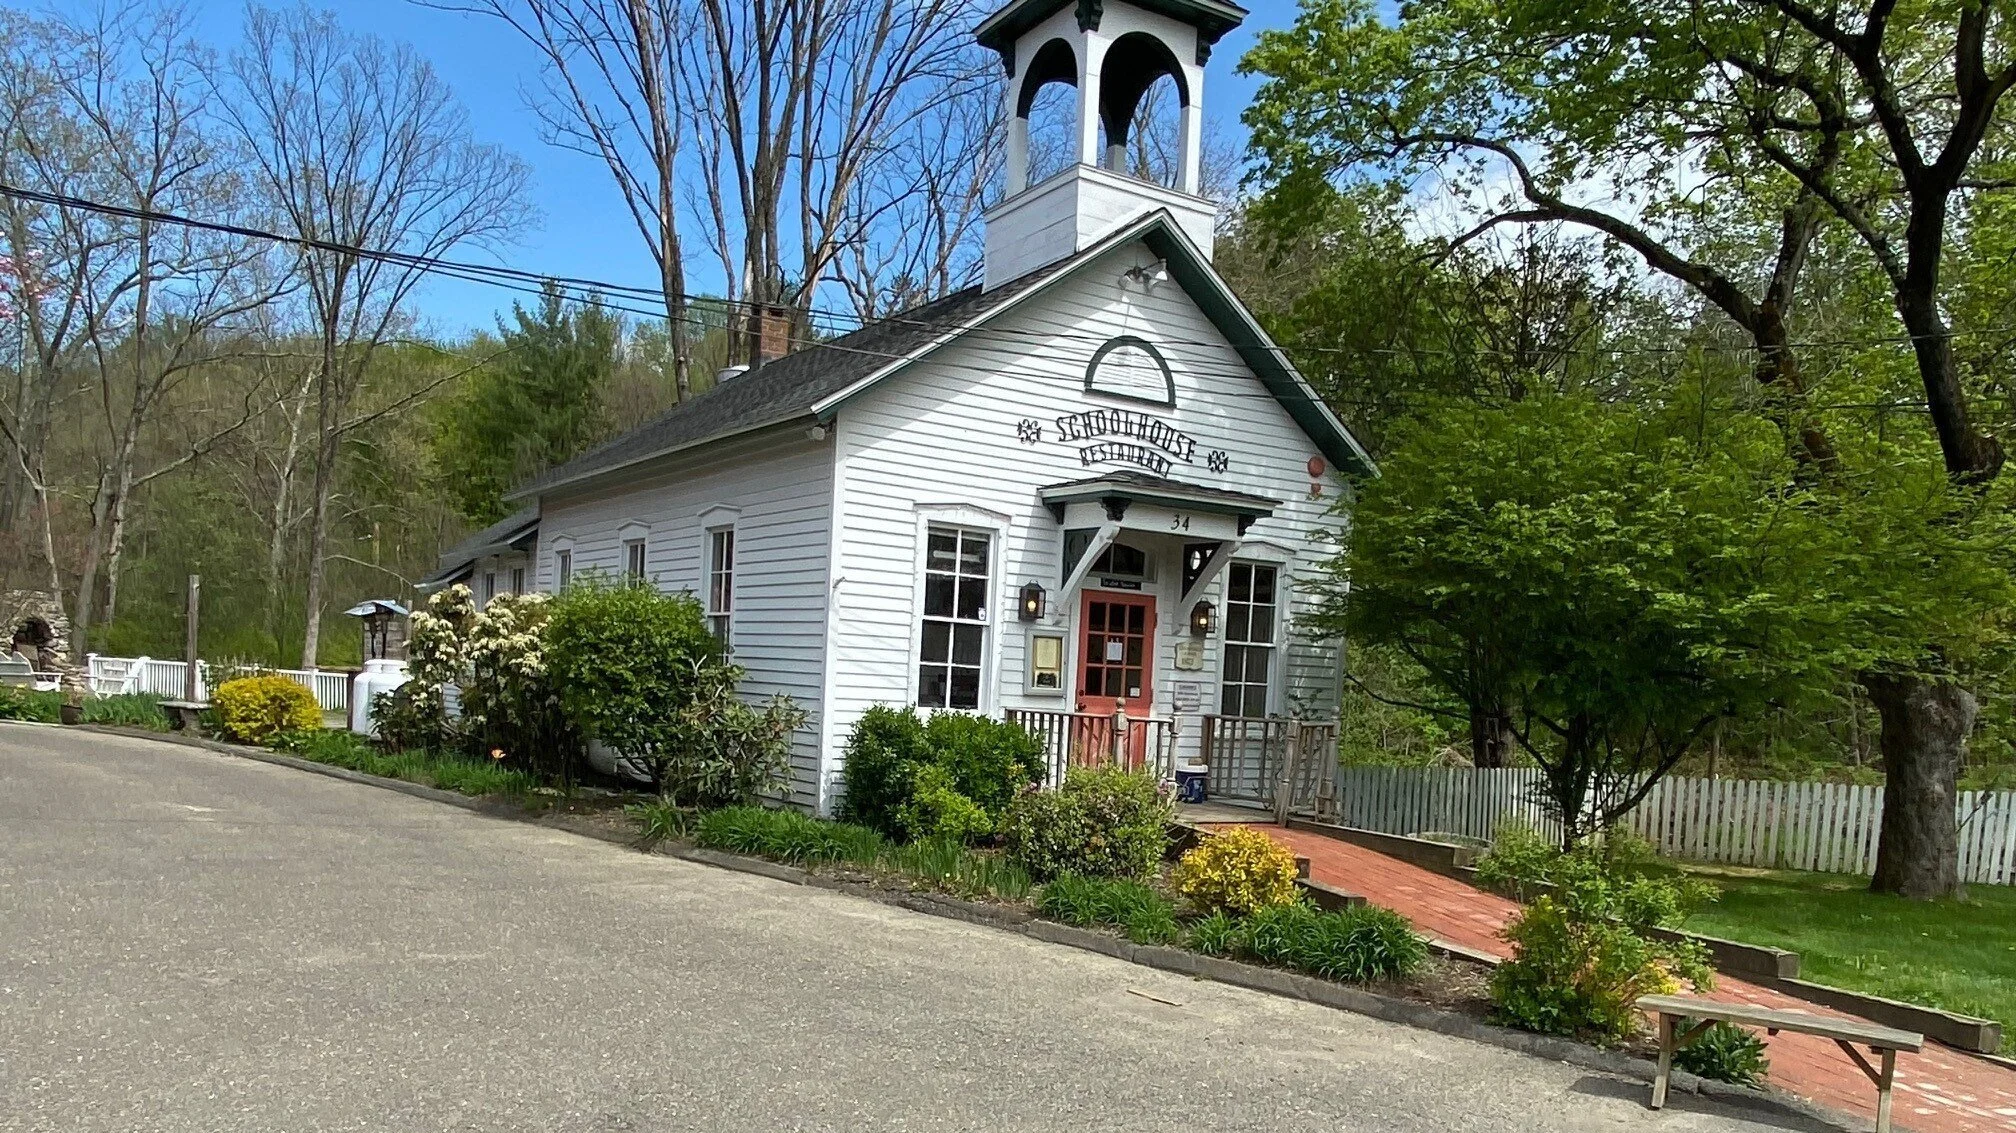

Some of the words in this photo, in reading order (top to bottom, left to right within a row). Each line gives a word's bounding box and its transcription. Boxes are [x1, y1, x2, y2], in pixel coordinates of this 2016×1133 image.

[1056, 409, 1197, 463] SCHOOLHOUSE
[1079, 442, 1173, 478] RESTAURANT
[1170, 514, 1190, 532] 34
